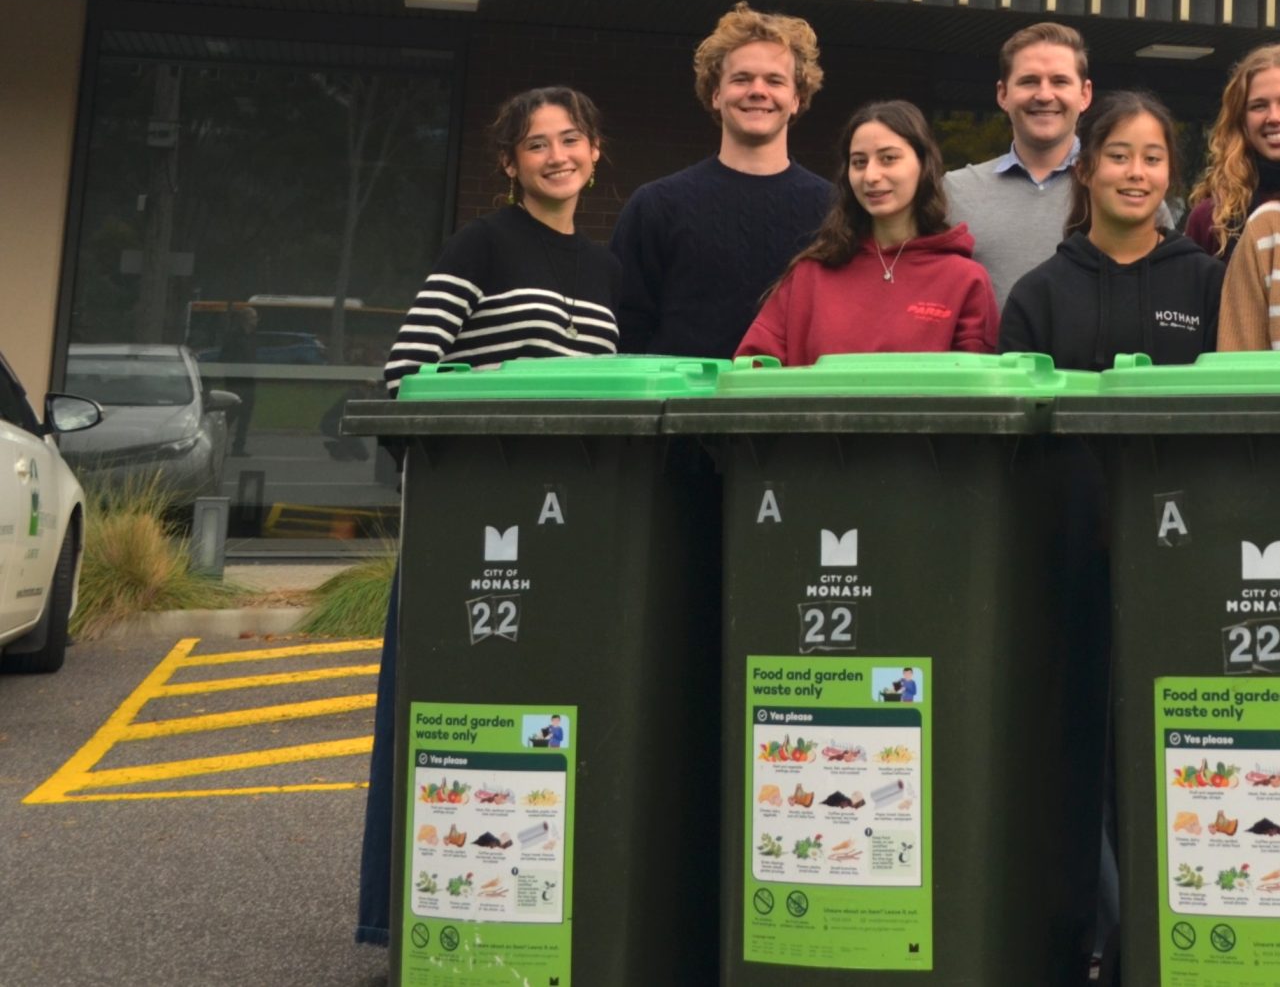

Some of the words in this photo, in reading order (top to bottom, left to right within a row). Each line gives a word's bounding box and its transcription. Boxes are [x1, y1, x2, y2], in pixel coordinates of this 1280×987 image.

[1155, 310, 1200, 326] HOTHAM
[537, 492, 565, 525] A
[756, 489, 782, 523] A
[1157, 501, 1188, 538] A
[483, 568, 504, 578] CITY
[506, 569, 518, 578] OF
[820, 574, 842, 584] CITY
[845, 574, 858, 584] OF
[471, 579, 531, 590] MONASH
[806, 585, 873, 597] MONASH
[1241, 588, 1267, 599] CITY
[471, 600, 518, 636] 22
[804, 607, 853, 643] 22
[753, 668, 783, 680] Food
[786, 669, 811, 681] and
[815, 669, 863, 684] garden
[753, 684, 792, 695] waste
[795, 684, 823, 699] only
[1163, 688, 1198, 701] Food
[1201, 689, 1230, 702] and
[770, 711, 784, 721] Yes
[785, 712, 813, 723] please
[1163, 705, 1208, 717] waste
[1211, 705, 1244, 722] only
[416, 713, 443, 726] Food
[445, 715, 467, 727] and
[470, 715, 515, 730] garden
[416, 729, 449, 740] waste
[452, 729, 478, 744] only
[1184, 734, 1200, 744] Yes
[1202, 734, 1234, 746] please
[430, 755, 442, 764] Yes
[443, 755, 468, 766] please
